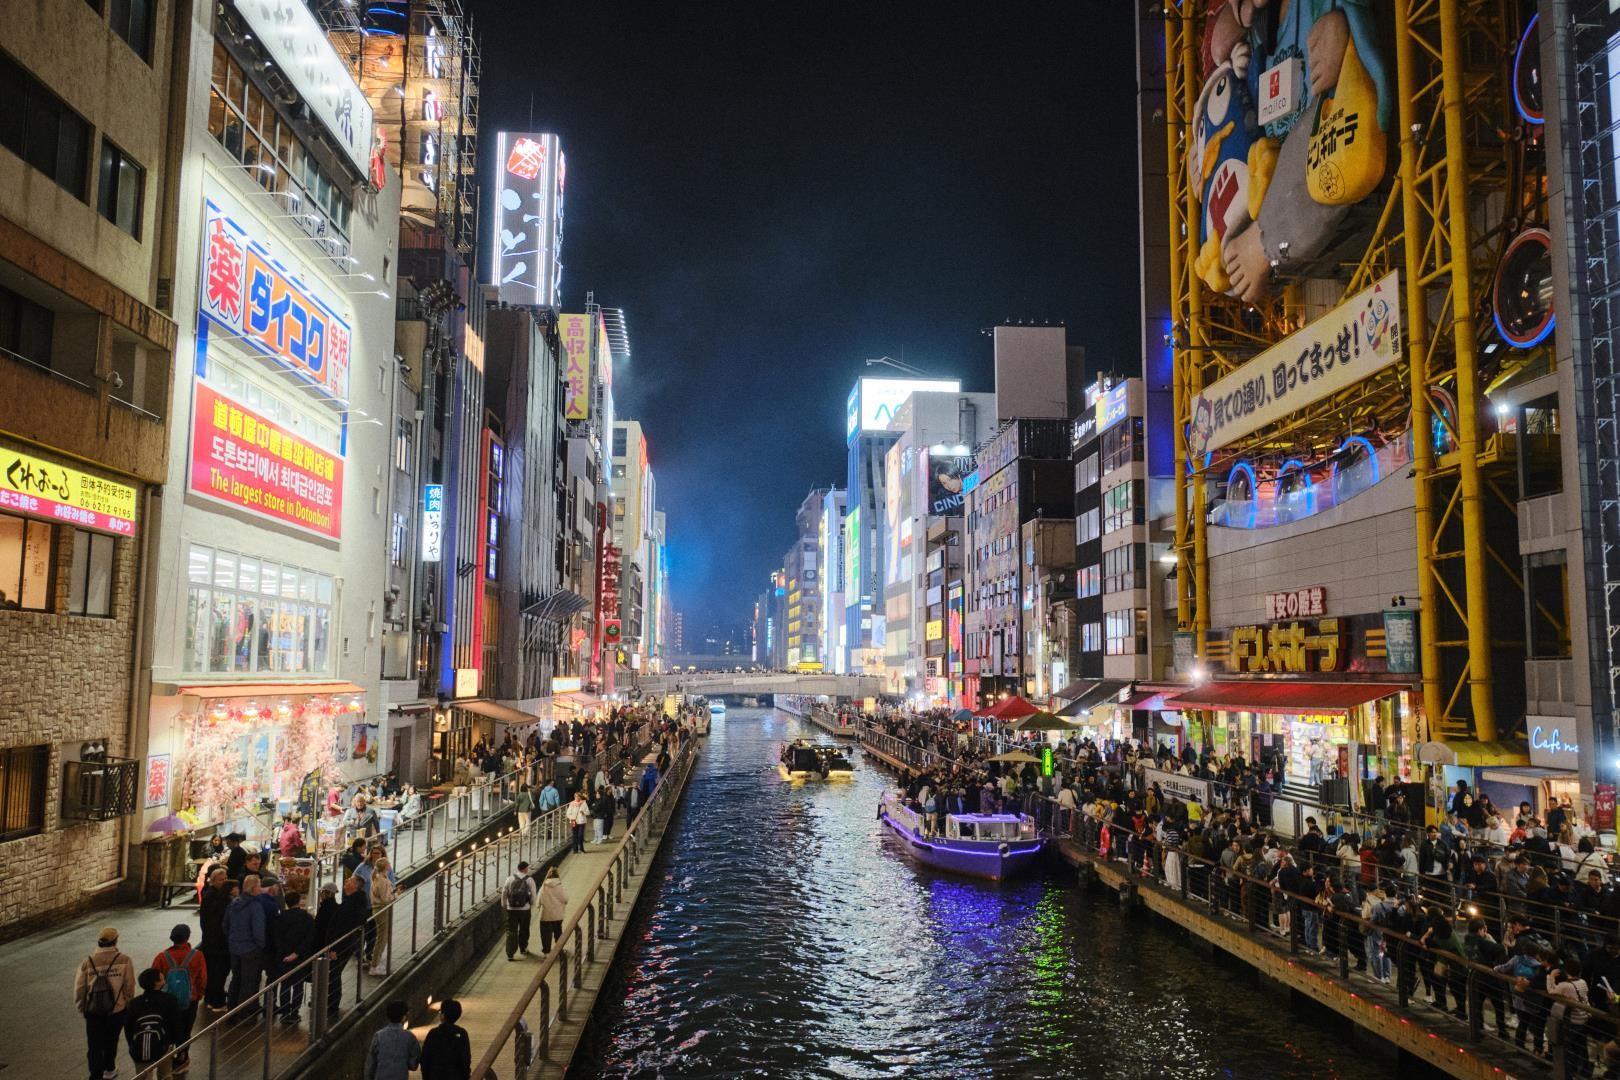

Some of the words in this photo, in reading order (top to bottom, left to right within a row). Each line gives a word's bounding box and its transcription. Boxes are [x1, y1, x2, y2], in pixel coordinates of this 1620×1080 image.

[208, 218, 242, 317] 薬
[250, 268, 325, 372] ダイコク
[7, 458, 69, 501] くれおーる
[211, 436, 279, 487] 도톤보리에서
[281, 467, 333, 506] 최대급인점포
[80, 476, 132, 501] 団体予約受付中
[211, 467, 228, 493] The
[231, 475, 263, 504] largest
[264, 490, 285, 512] store
[286, 498, 294, 516] in
[295, 501, 331, 530] Dotonbori
[429, 487, 441, 511] 焼肉
[54, 504, 96, 525] お好み焼き
[80, 498, 90, 508] 06
[92, 501, 112, 513] 6212
[1265, 587, 1323, 620] 驚安の殿堂
[1387, 619, 1413, 644] 薬
[1532, 726, 1560, 753] Cafe
[148, 758, 167, 801] 薬
